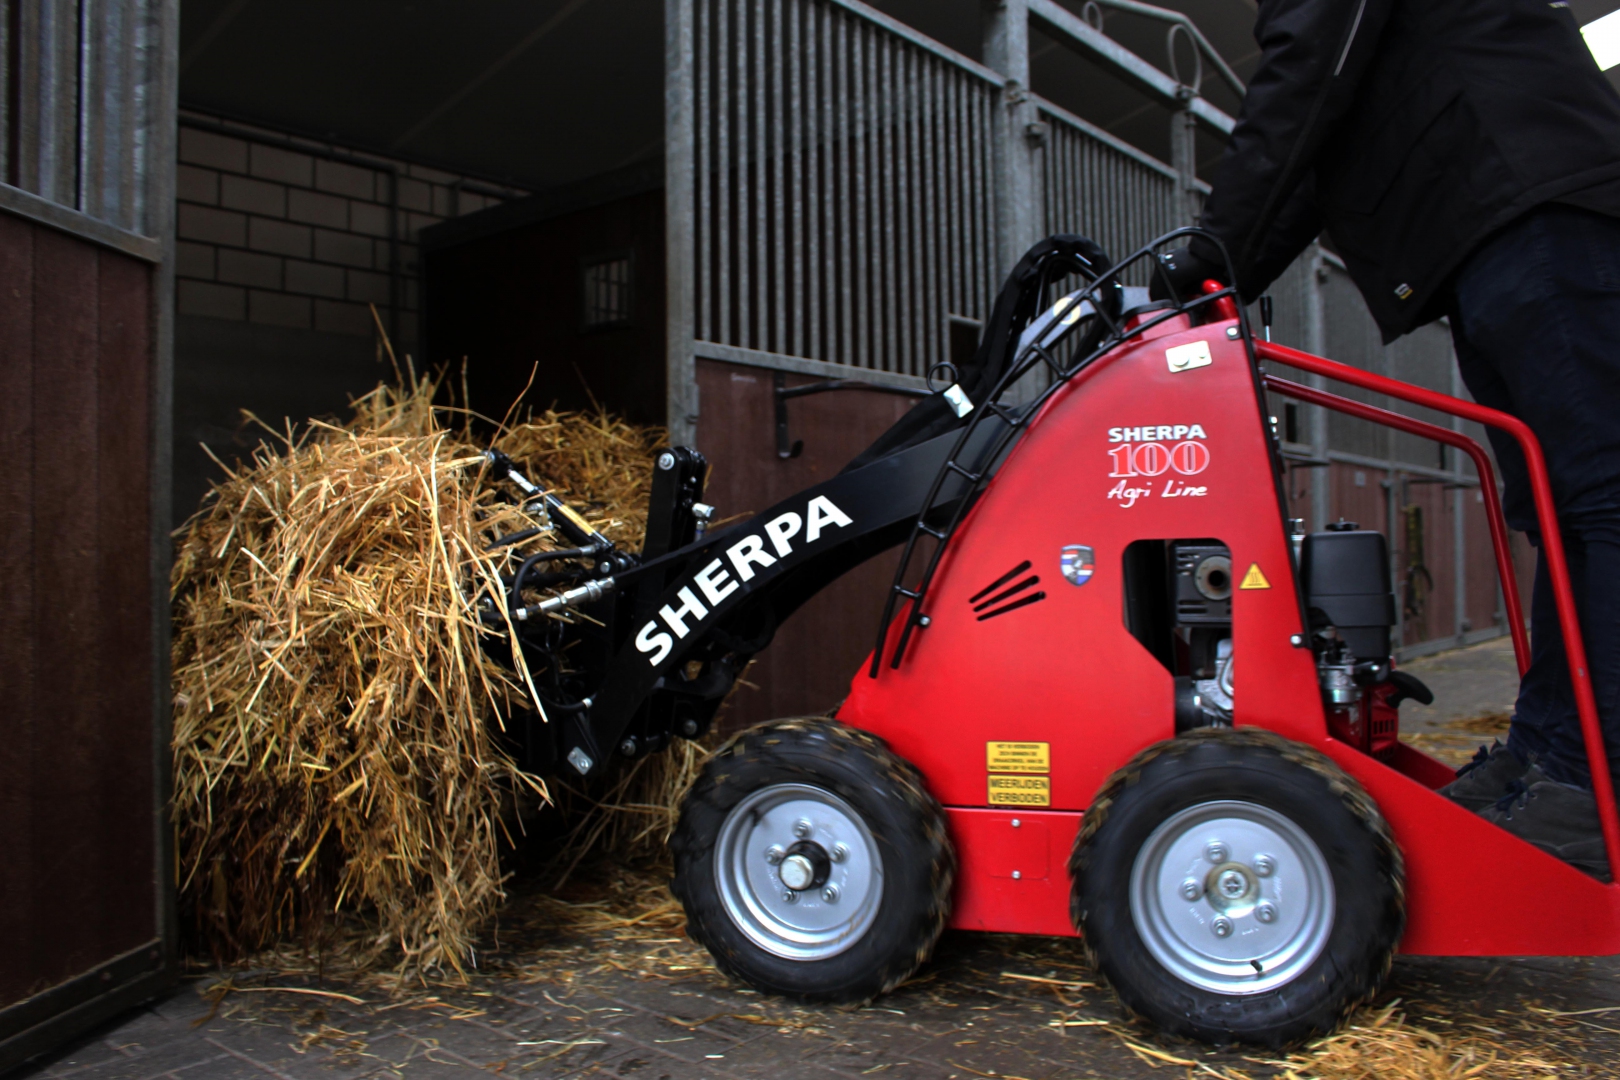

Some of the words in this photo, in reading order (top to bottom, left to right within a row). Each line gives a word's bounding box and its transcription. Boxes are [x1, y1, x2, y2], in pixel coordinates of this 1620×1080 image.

[1108, 424, 1207, 442] SHERPA
[1108, 441, 1210, 478] 100
[1107, 480, 1153, 508] Agri
[1161, 480, 1209, 498] Line
[635, 495, 853, 667] SHERPA
